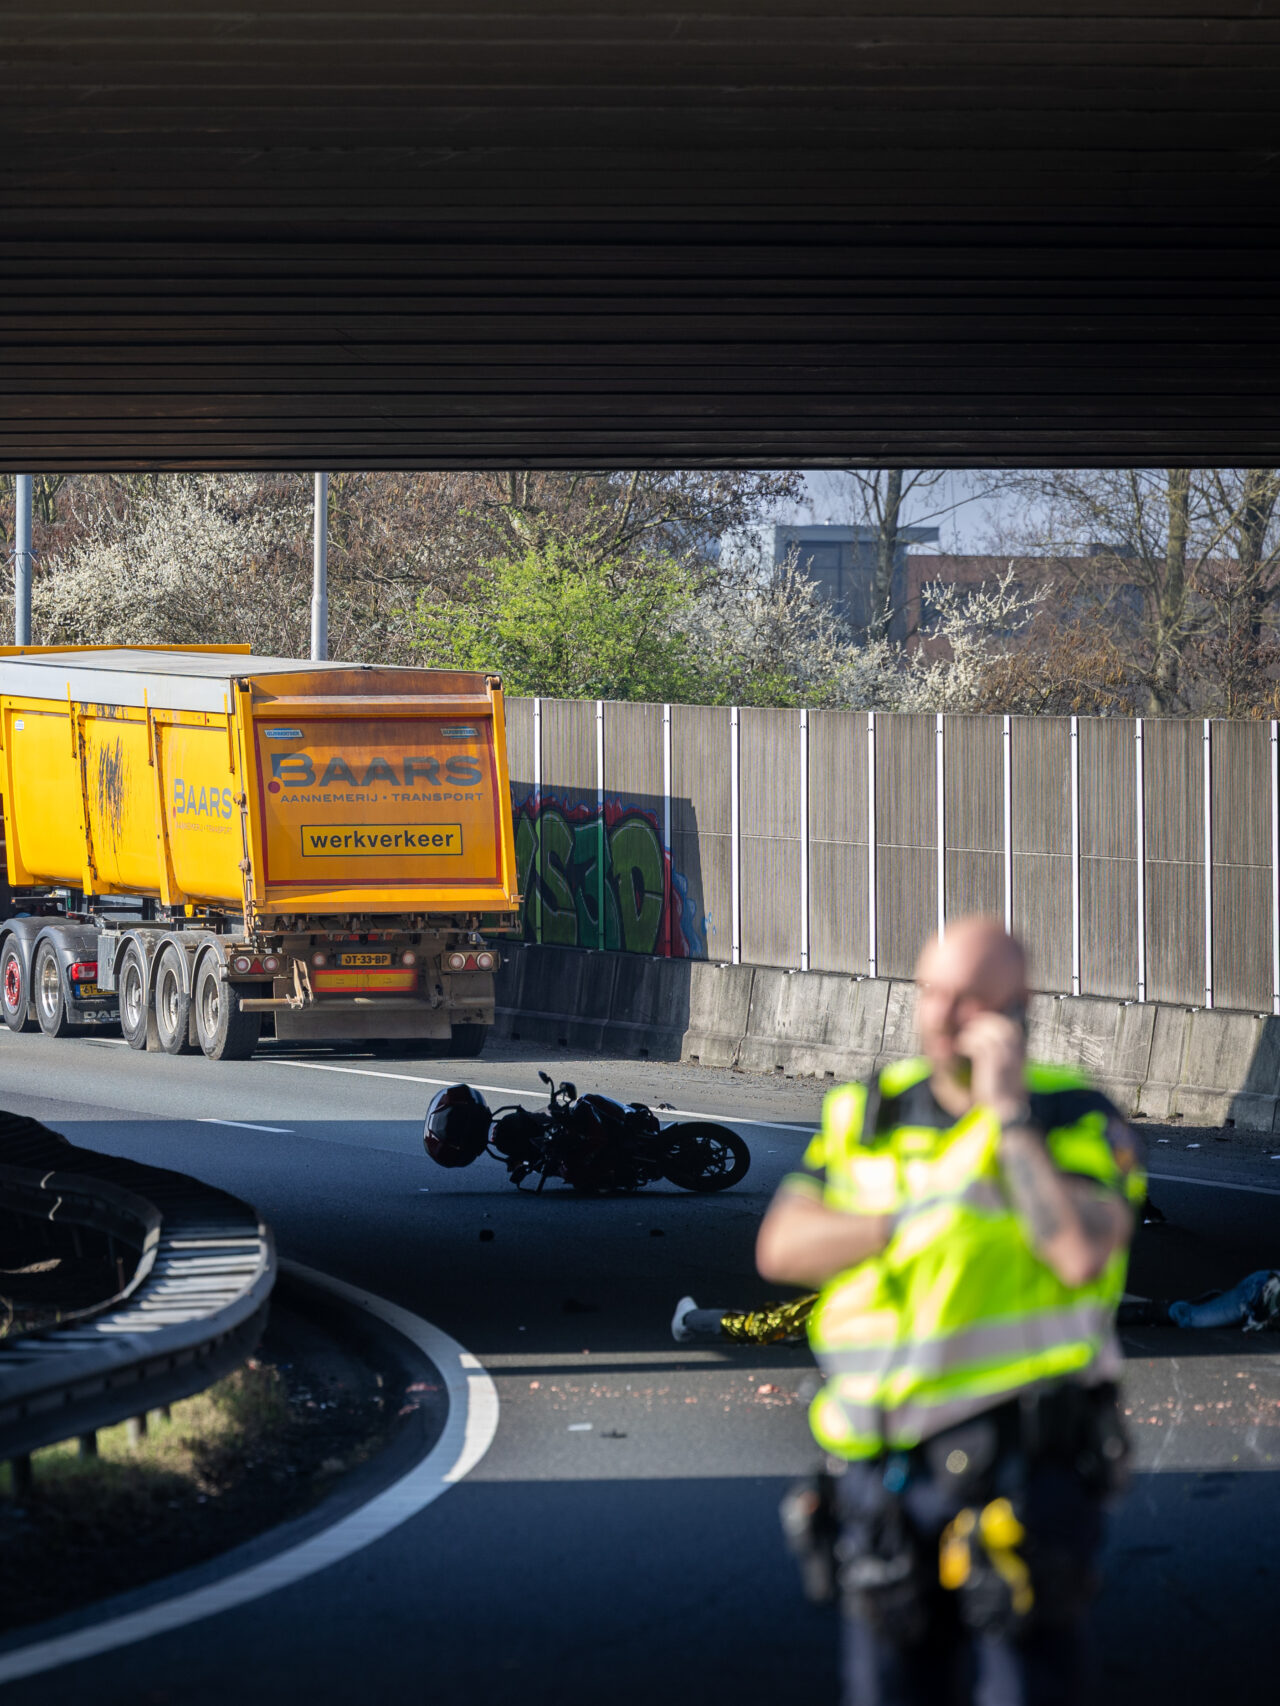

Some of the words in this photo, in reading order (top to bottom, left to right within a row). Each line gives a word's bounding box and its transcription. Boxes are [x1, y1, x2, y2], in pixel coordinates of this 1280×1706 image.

[270, 753, 483, 788] BAARS
[174, 778, 232, 820] BAARS
[280, 793, 378, 803] AANNEMERIJ
[391, 792, 484, 802] TRANSPORT
[309, 830, 454, 849] werkverkeer
[83, 1010, 120, 1019] DAF
